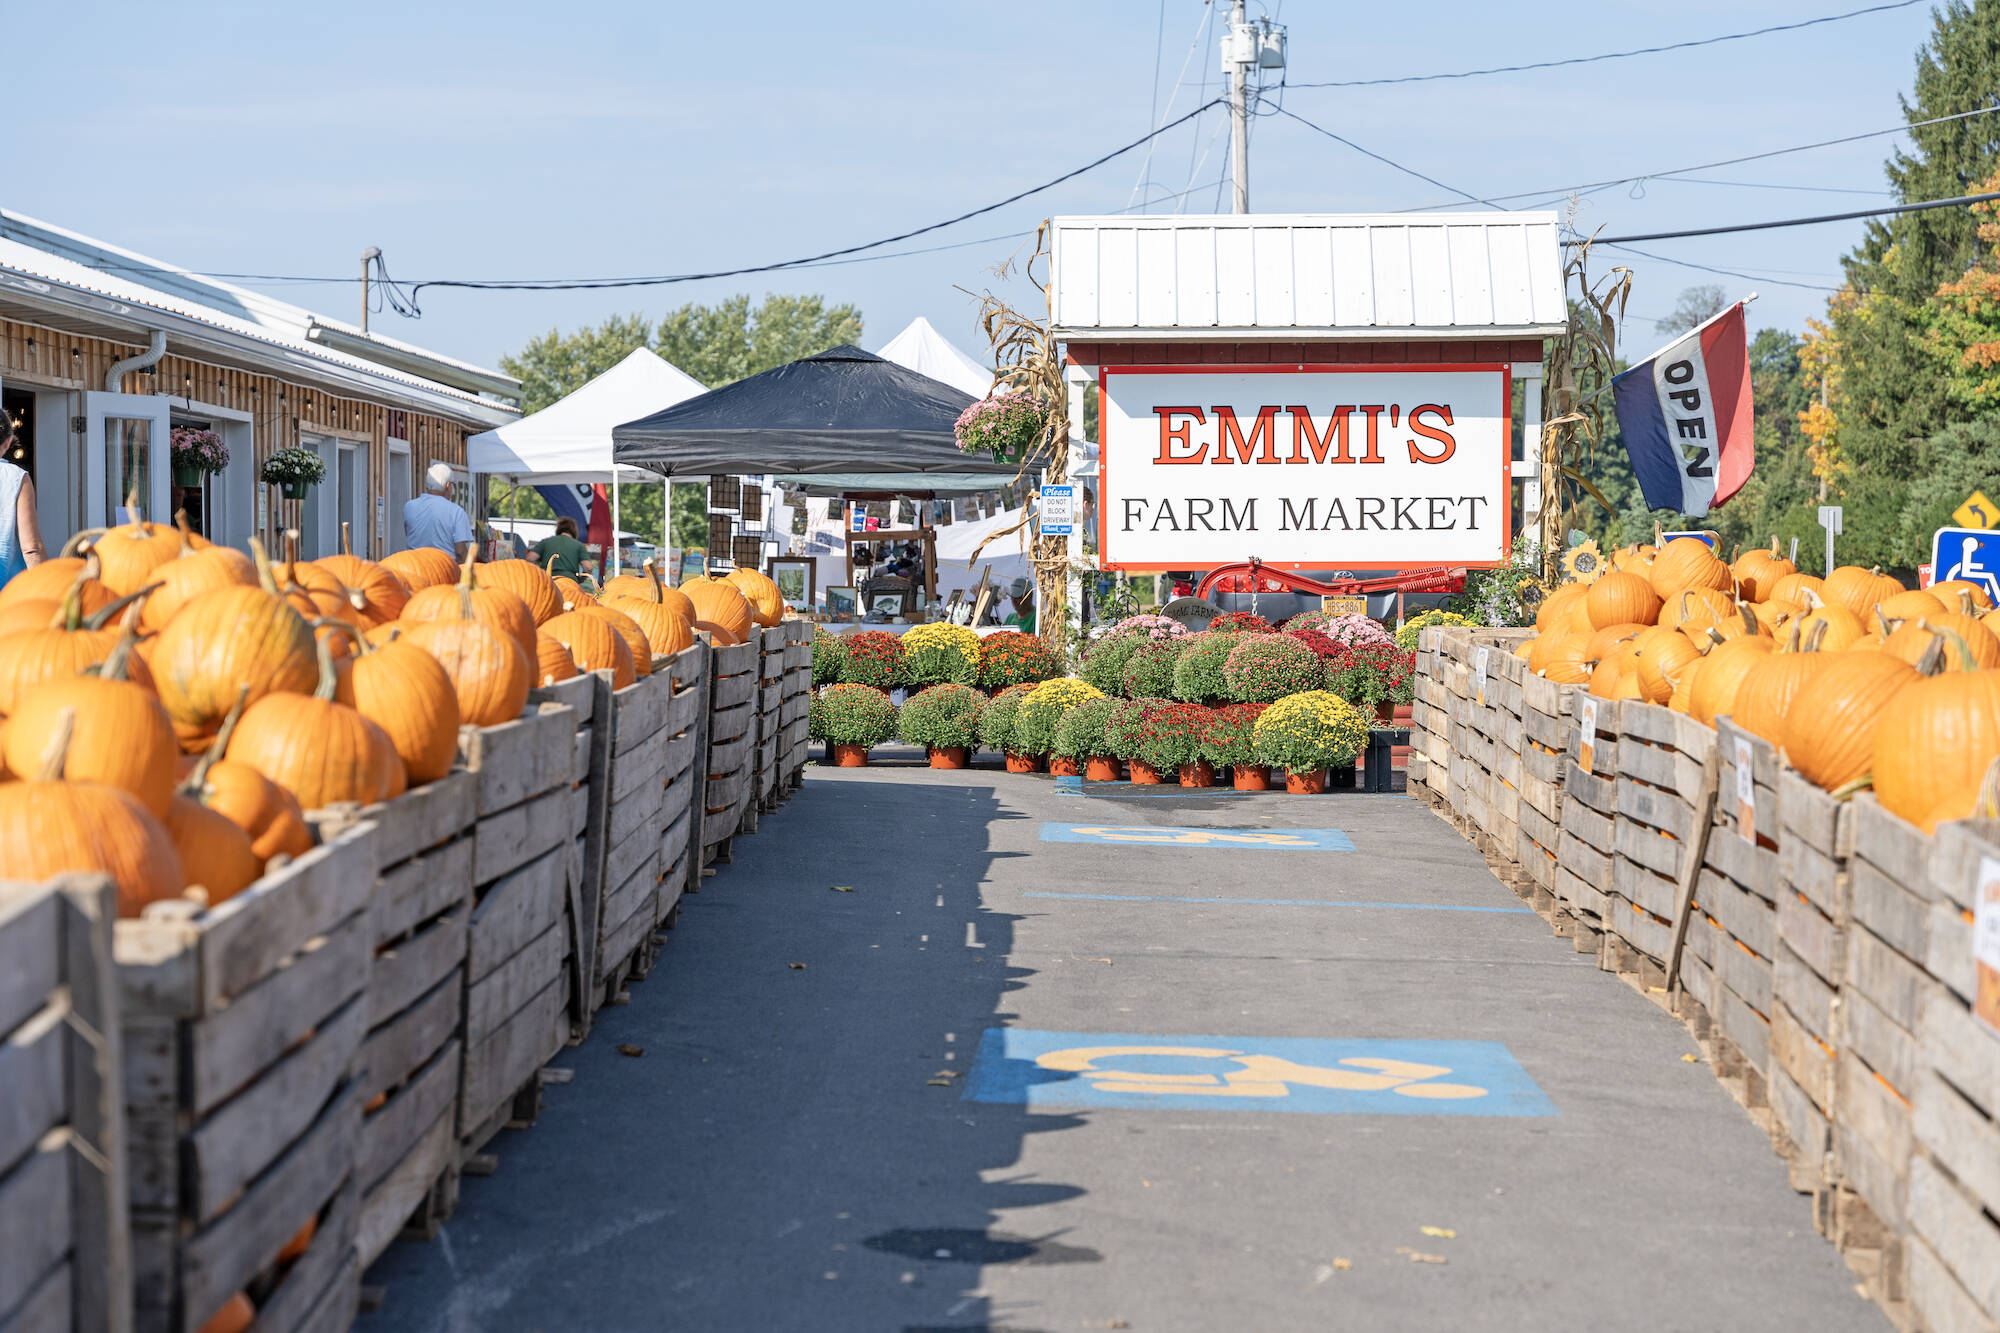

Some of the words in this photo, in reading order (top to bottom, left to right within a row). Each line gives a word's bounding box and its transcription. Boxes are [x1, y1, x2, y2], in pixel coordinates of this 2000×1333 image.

[1152, 404, 1457, 465] EMMI'S
[1664, 359, 1713, 477] OPEN
[1044, 487, 1071, 495] Please
[1121, 498, 1259, 532] FARM
[1278, 496, 1488, 531] MARKET
[1920, 566, 1931, 575] TO
